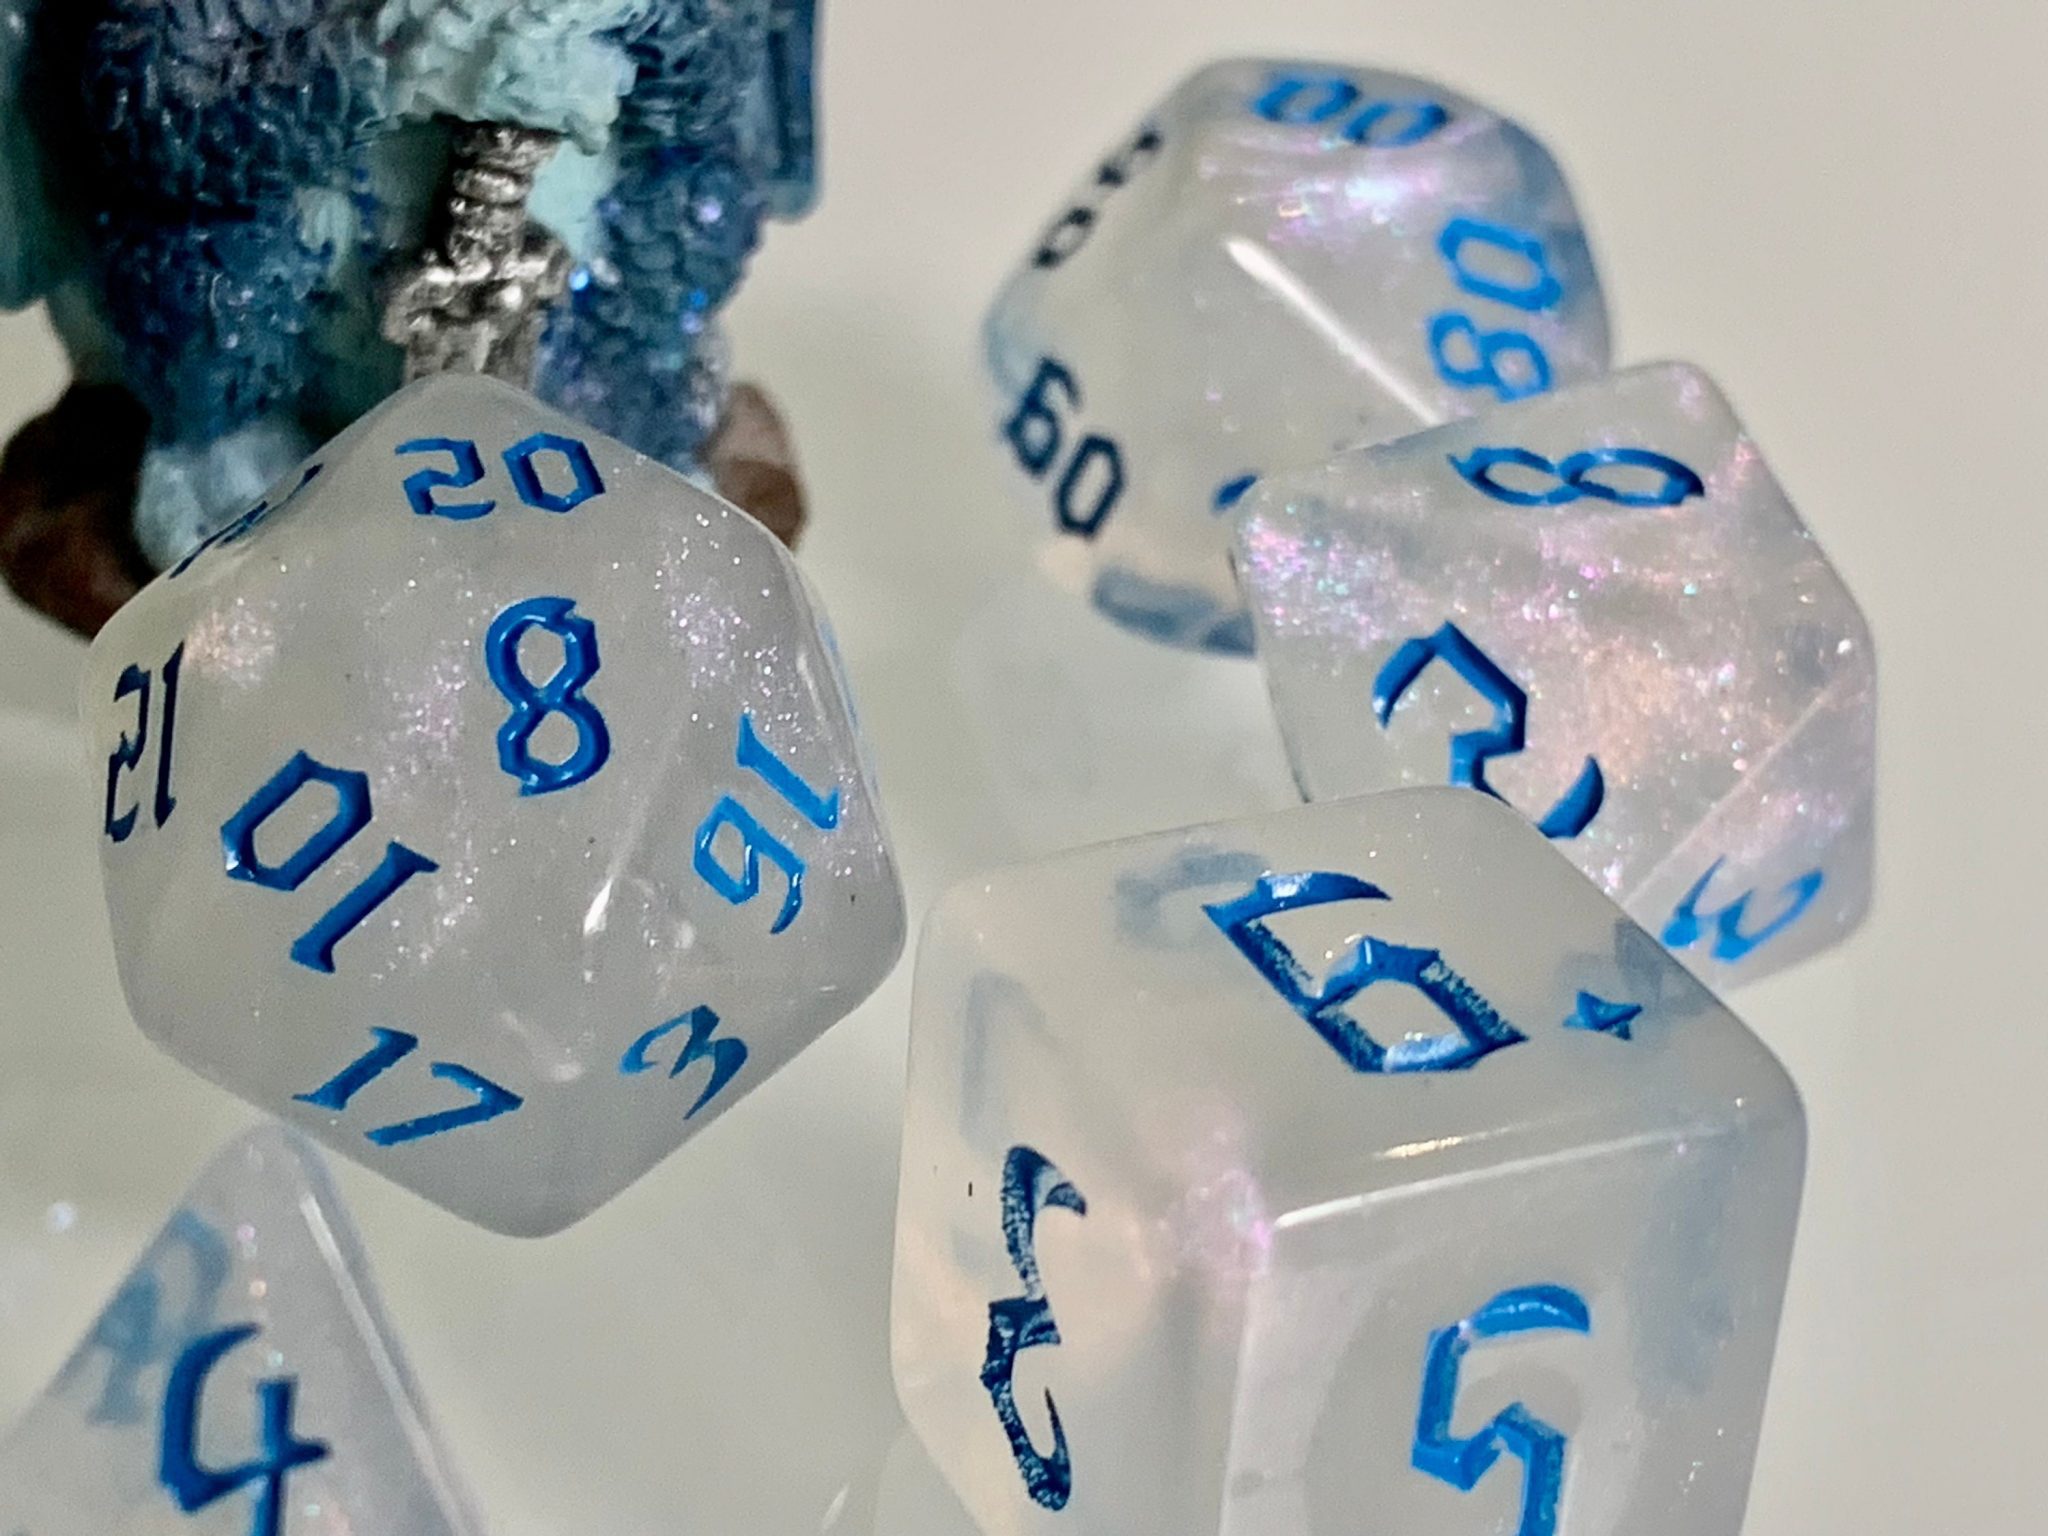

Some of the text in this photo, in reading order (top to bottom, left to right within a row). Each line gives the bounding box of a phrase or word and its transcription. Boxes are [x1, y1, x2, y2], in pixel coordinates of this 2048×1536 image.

[1247, 70, 1451, 149] 00
[1424, 218, 1562, 402] 80
[396, 433, 606, 521] 20
[1003, 358, 1125, 538] 60
[1449, 445, 1705, 508] 8
[484, 595, 612, 798] 8
[220, 750, 439, 974] 10
[1658, 857, 1828, 965] 3
[616, 1005, 750, 1119] 3
[1201, 871, 1530, 1075] 6
[293, 1027, 524, 1147] 17
[156, 1325, 330, 1536] 4
[1409, 1283, 1594, 1536] 5
